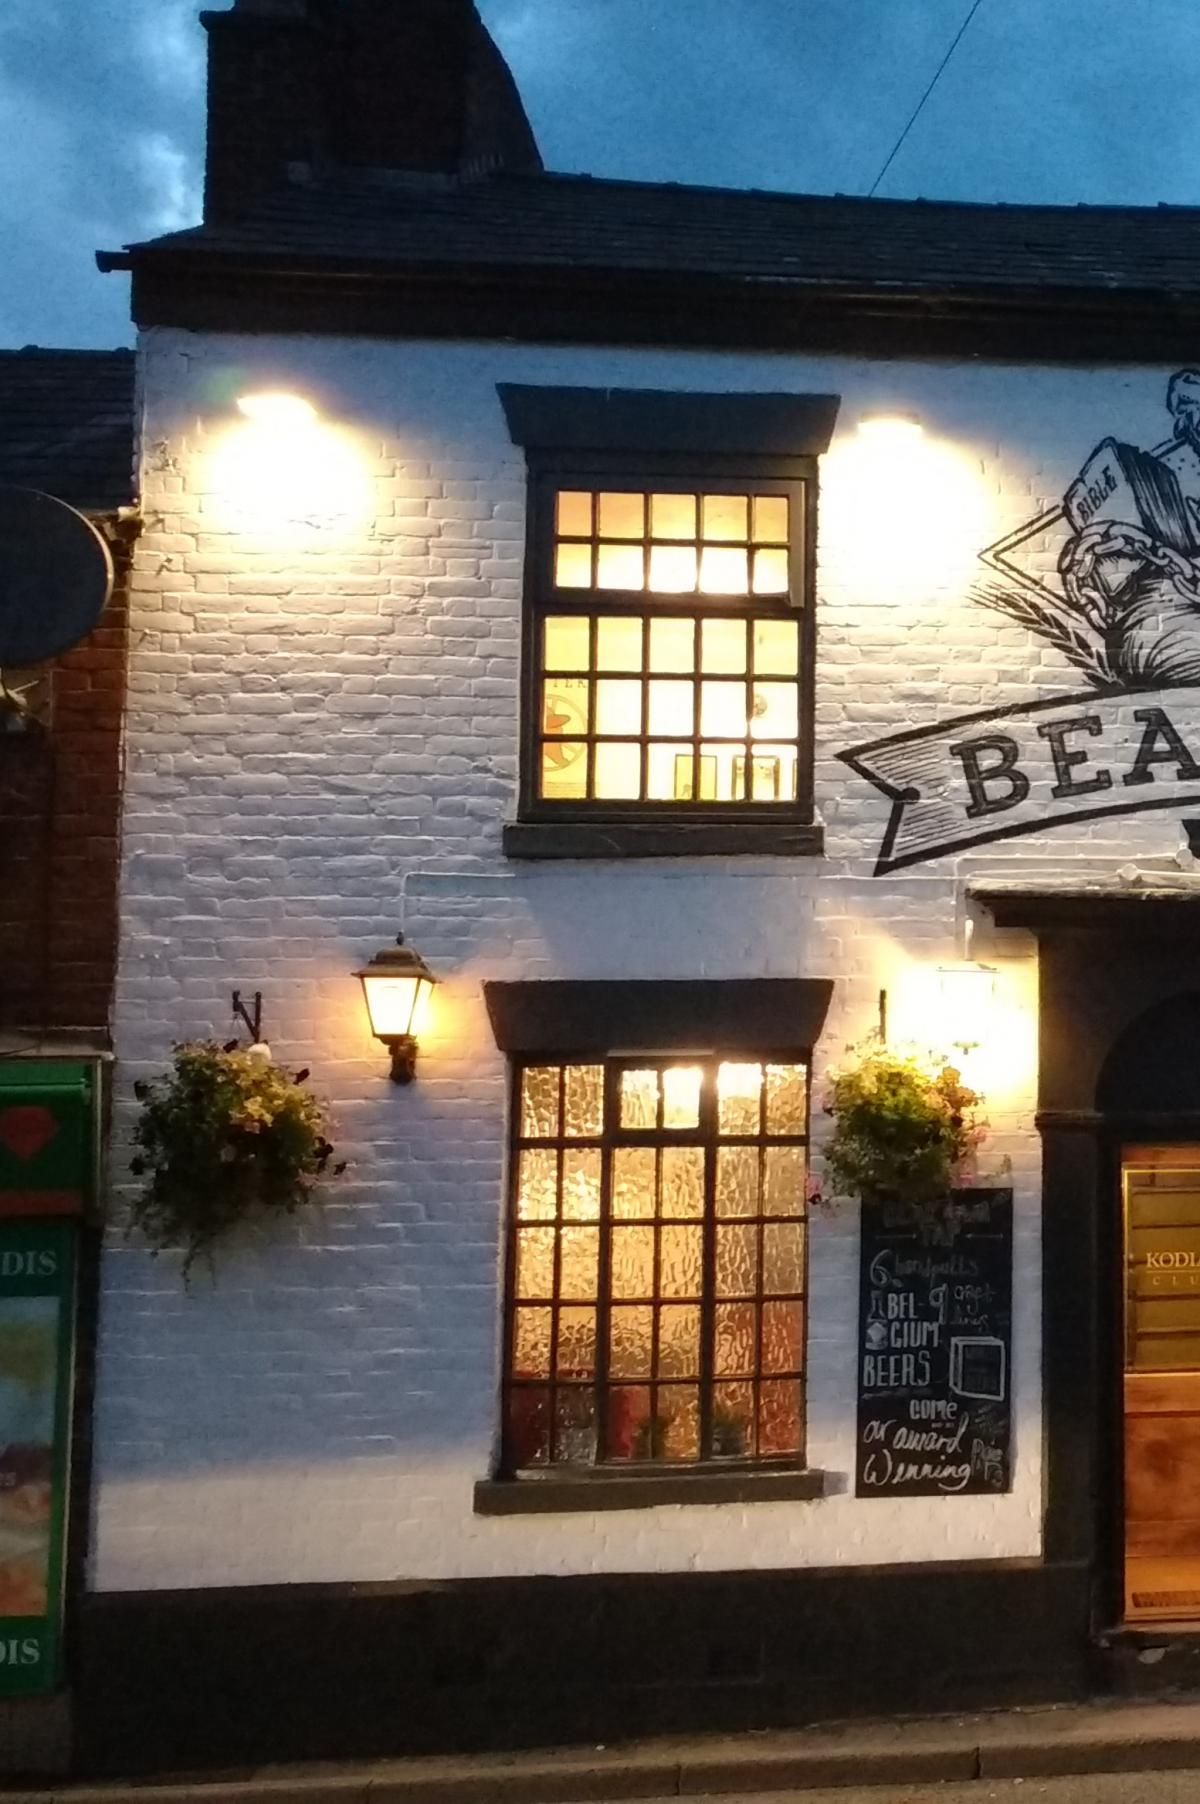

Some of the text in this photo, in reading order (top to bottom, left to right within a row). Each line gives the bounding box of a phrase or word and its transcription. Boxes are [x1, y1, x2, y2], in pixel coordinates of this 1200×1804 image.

[1076, 463, 1118, 525] BIBLE
[863, 1350, 930, 1387] BEERS
[893, 1411, 969, 1453] award
